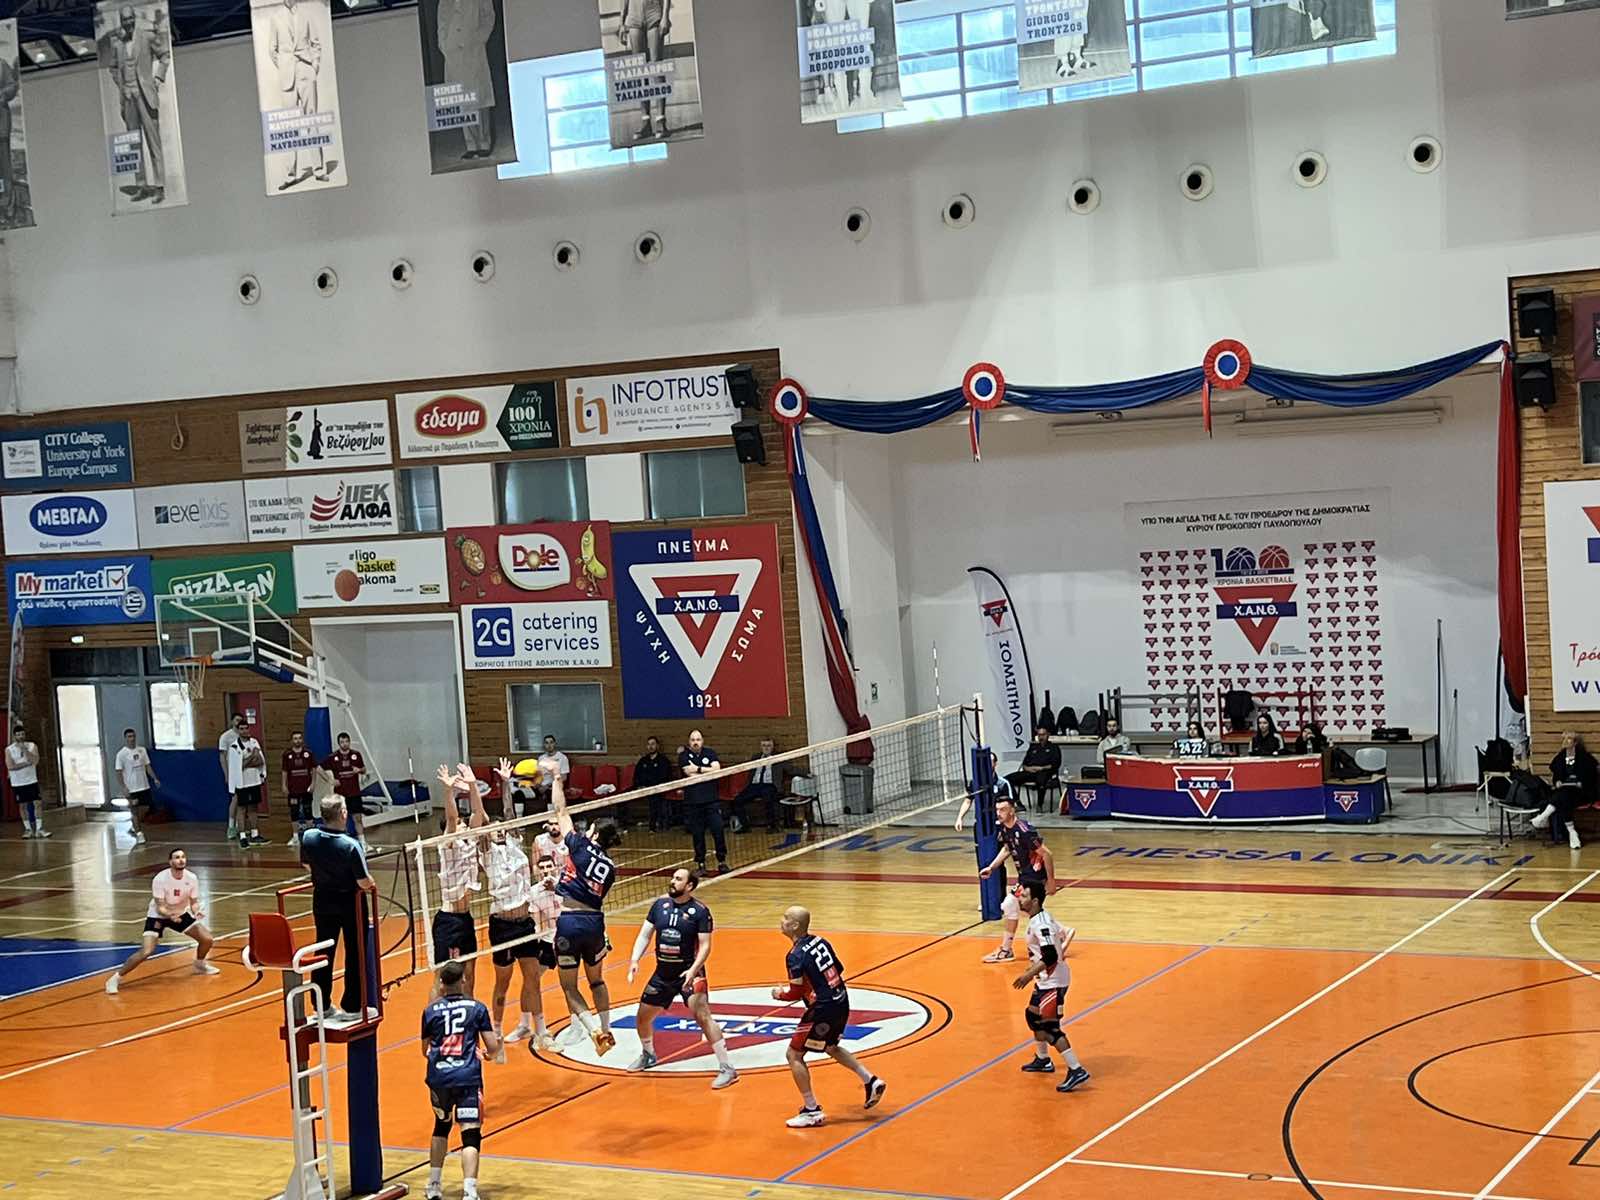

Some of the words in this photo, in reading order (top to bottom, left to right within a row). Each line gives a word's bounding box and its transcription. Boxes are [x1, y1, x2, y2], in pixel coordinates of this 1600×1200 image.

[1026, 12, 1070, 27] GIORGOS
[1027, 22, 1082, 39] TRONTZOS
[809, 45, 864, 61] THEODOROS
[809, 56, 870, 72] RODOPOULOS
[615, 78, 642, 91] TAKIS
[616, 86, 672, 101] TALIADOROS
[509, 406, 536, 421] 100
[614, 406, 670, 418] INSURANCE
[673, 402, 712, 413] AGENTS
[510, 420, 552, 433] ΧΡΟΝΙΑ
[45, 434, 69, 446] CITY
[70, 432, 107, 446] College,
[46, 448, 91, 462] University
[92, 446, 101, 458] of
[104, 445, 125, 458] York
[48, 465, 80, 479] Europe
[81, 463, 117, 477] Campus
[38, 507, 99, 526] ΜΕΒΓΑΛ
[170, 499, 229, 523] exelixis
[340, 502, 391, 521] ΑΛΦΑ
[1234, 511, 1250, 520] ΤΟΥ
[1251, 509, 1294, 519] ΠΡΟΕΔΡΟΥ
[1295, 508, 1311, 516] ΤΗΣ
[1312, 504, 1371, 516] ΔΗΜΟΚΡΑΤΙΑΣ
[1263, 518, 1322, 528] ΠΑΥΛΟΠΟΥΛΟΥ
[658, 539, 729, 554] ΠΝΕΥΜΑ
[512, 544, 560, 569] Dole
[357, 561, 396, 573] basket
[18, 575, 42, 595] My
[44, 571, 103, 592] market
[1246, 576, 1293, 584] BASKETBALL
[674, 599, 722, 612] Χ.Α.Ν.Θ.
[1234, 605, 1279, 616] Χ.Α.Ν.Θ.
[476, 617, 511, 647] 2G
[523, 612, 598, 633] catering
[635, 610, 671, 664] ΨΥΧΗ
[731, 607, 764, 662] ΣΩΜΑ
[524, 633, 600, 651] services
[688, 694, 721, 708] 1921
[1073, 846, 1535, 865] THESSALONIKI
[585, 857, 610, 884] 19
[810, 943, 834, 972] 23
[442, 1008, 467, 1035] 12
